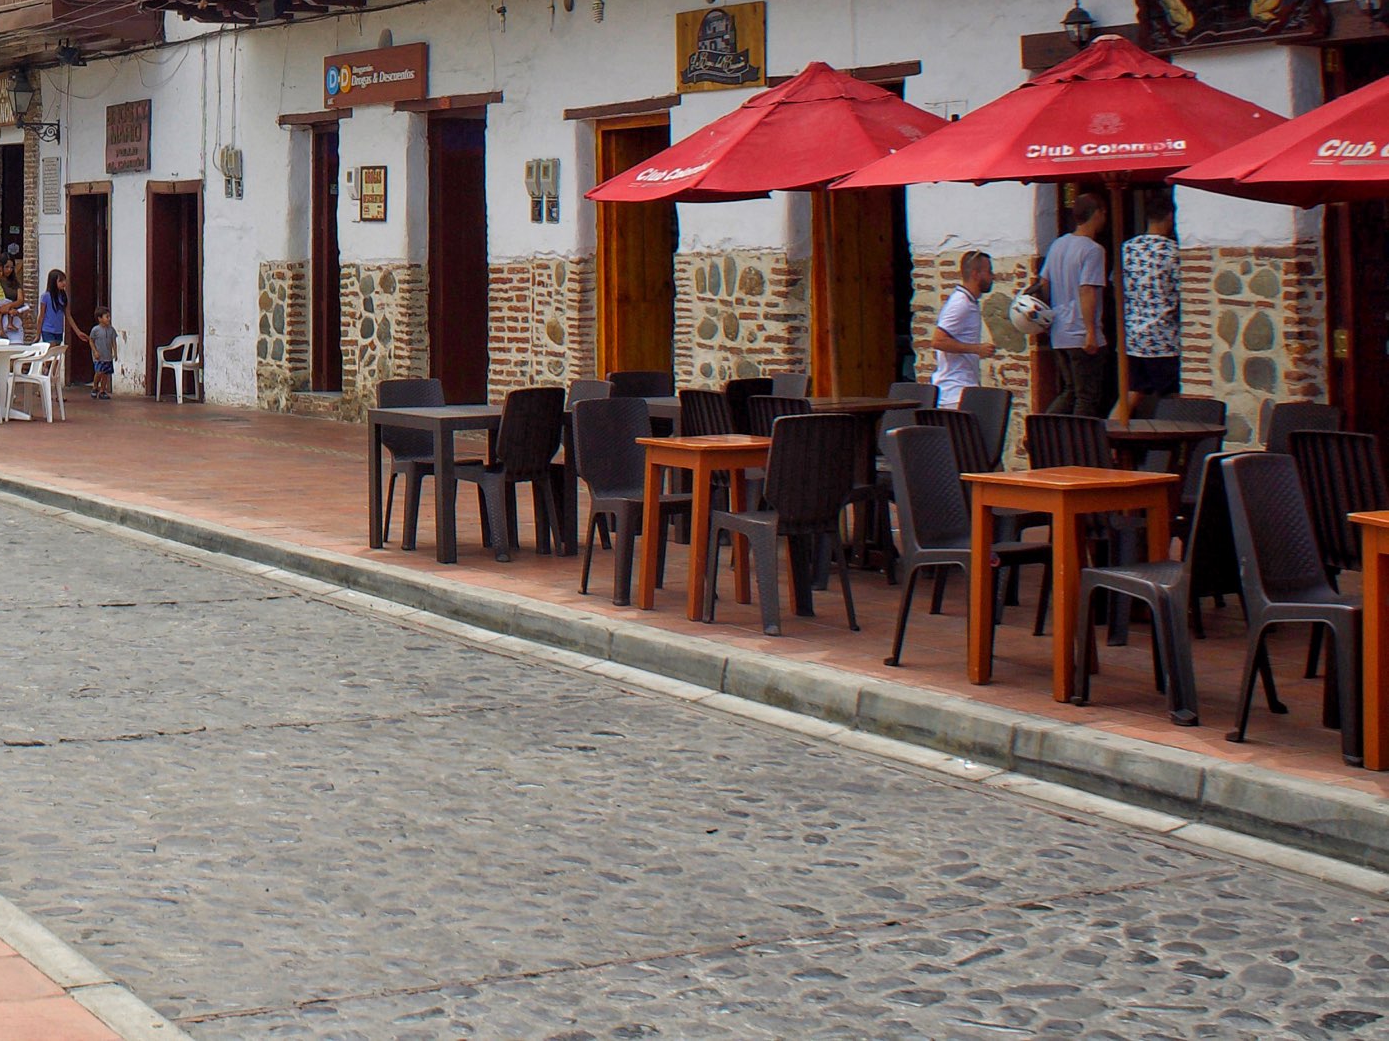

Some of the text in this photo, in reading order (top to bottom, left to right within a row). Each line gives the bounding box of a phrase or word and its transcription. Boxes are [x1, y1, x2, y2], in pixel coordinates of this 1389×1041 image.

[351, 69, 416, 89] Drogas & Descuentos
[1026, 144, 1075, 158] Club
[1317, 139, 1377, 157] Club
[636, 167, 668, 181] Club
